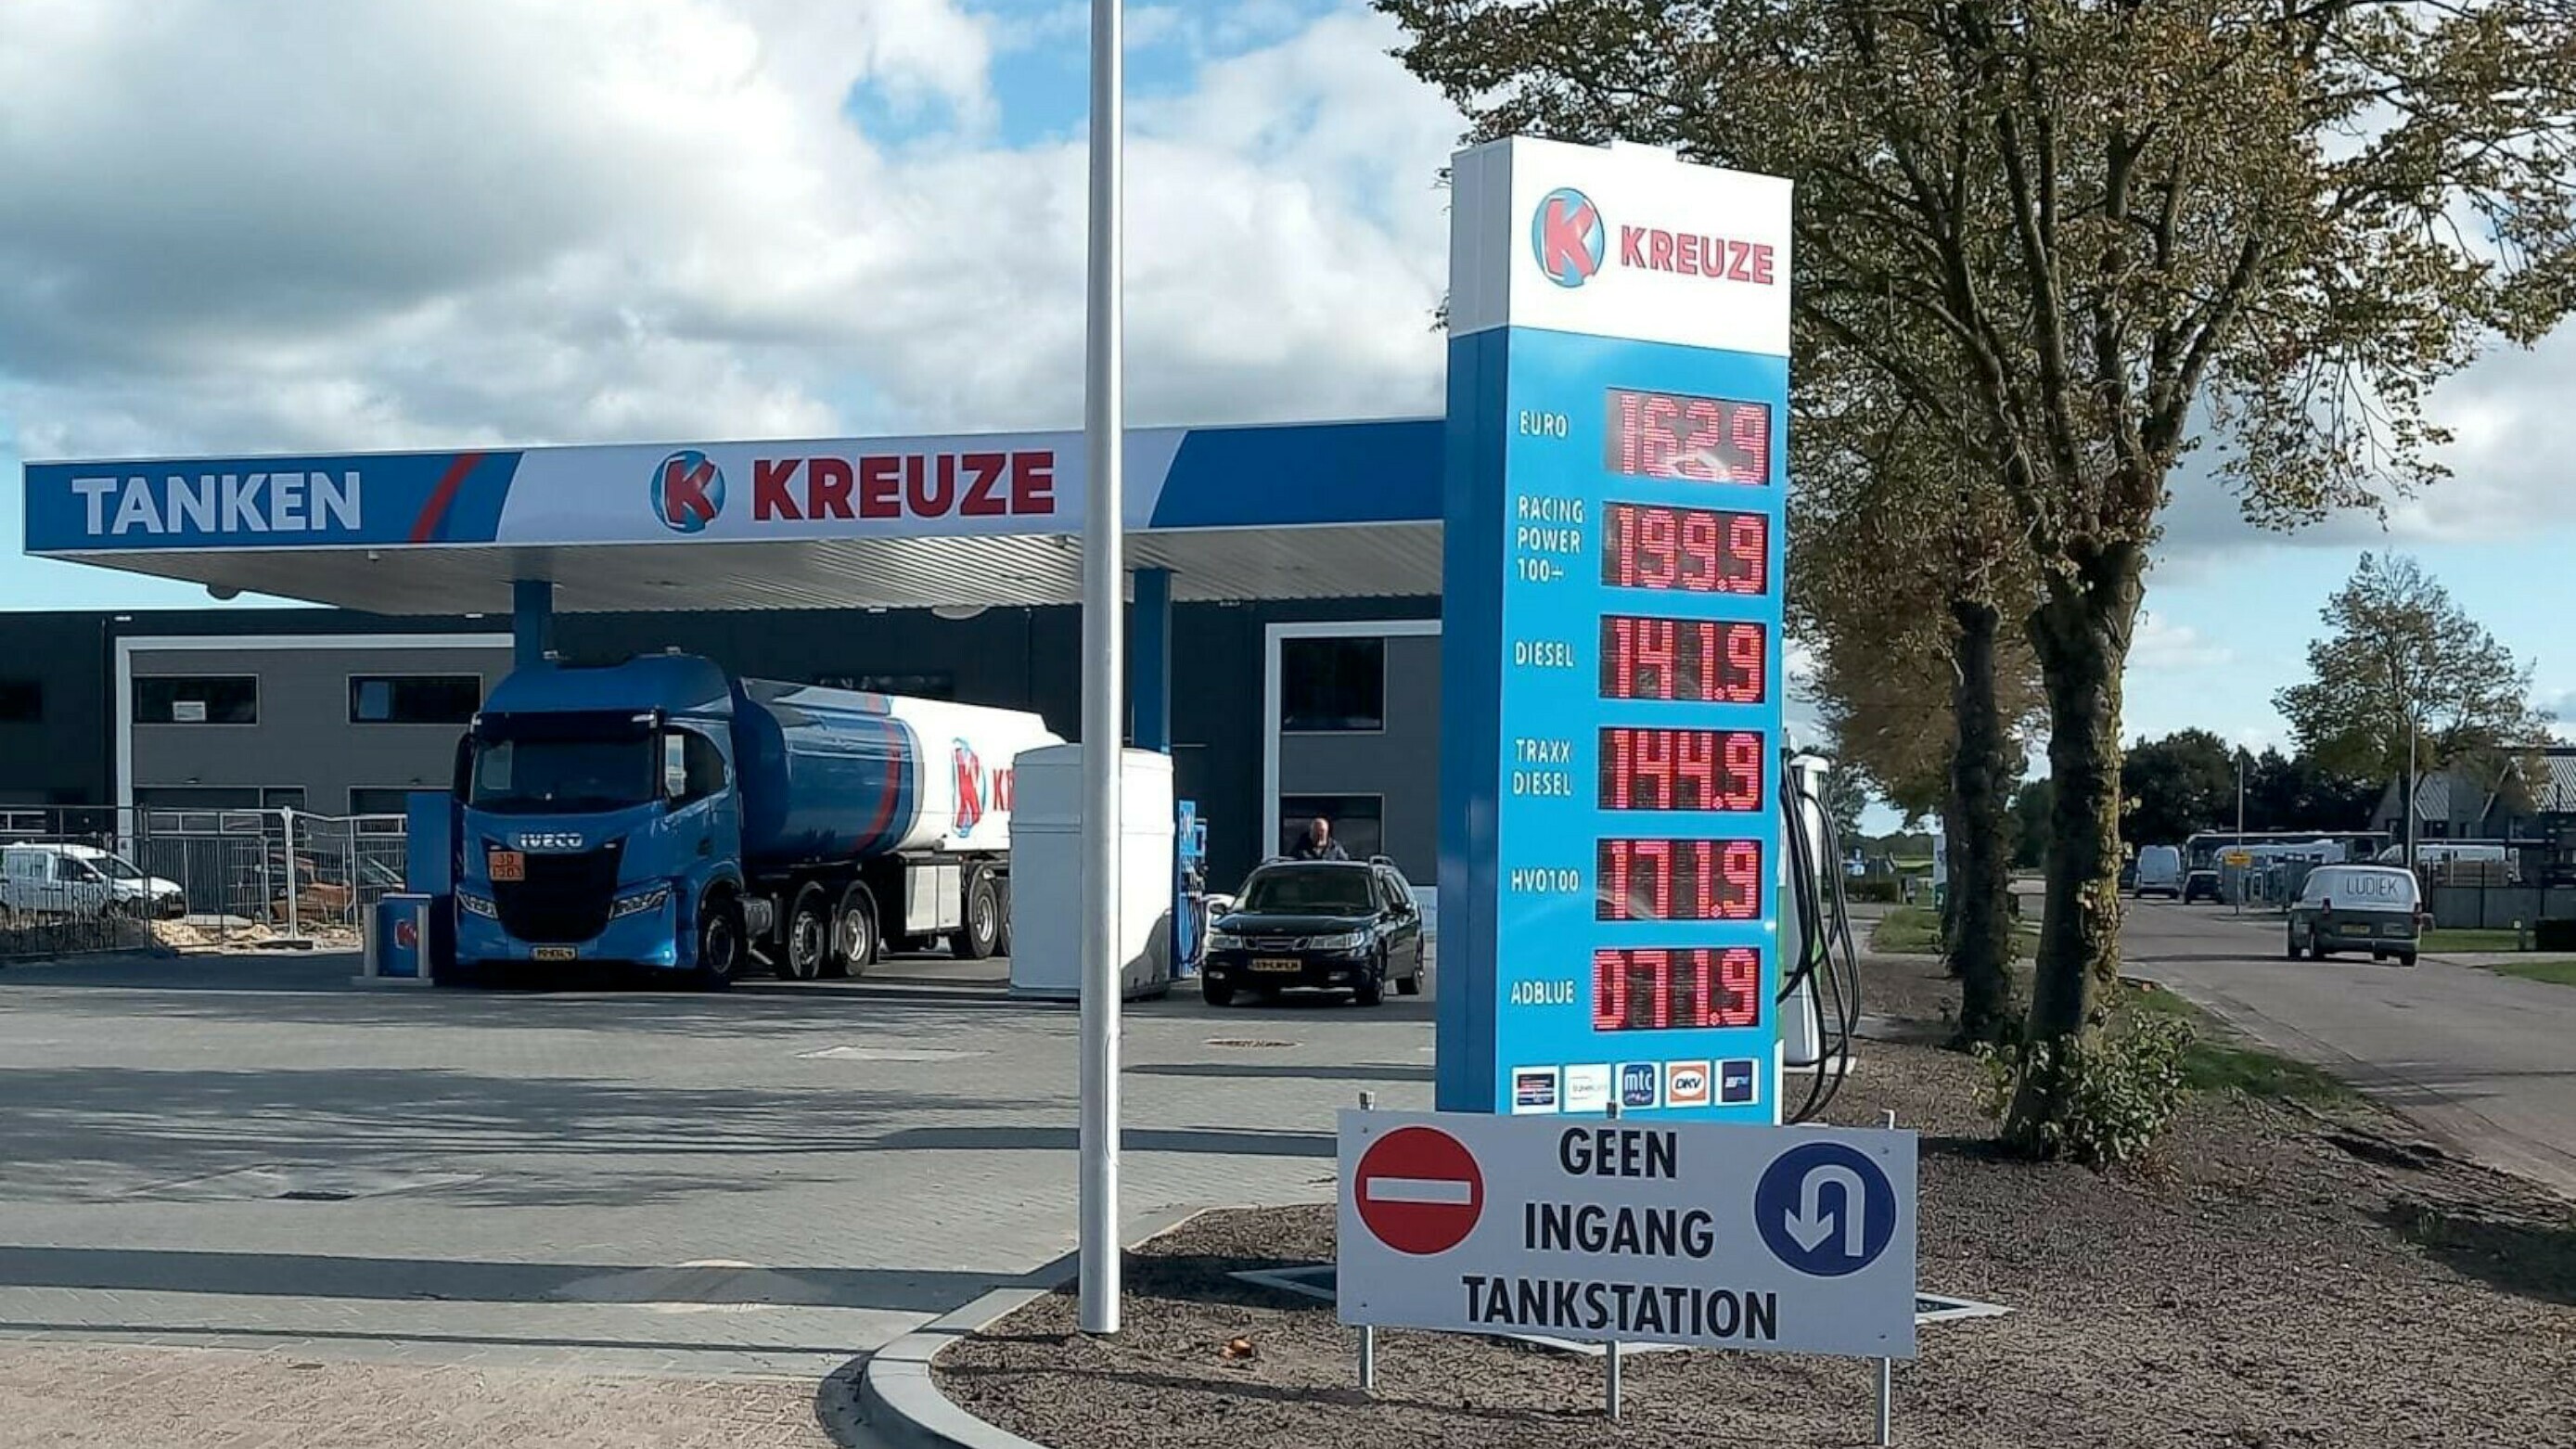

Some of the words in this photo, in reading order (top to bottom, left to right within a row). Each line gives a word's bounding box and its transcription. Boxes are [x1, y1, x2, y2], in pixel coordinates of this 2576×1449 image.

[1621, 224, 1774, 285] KREUZE
[1519, 410, 1568, 437] EURO
[753, 451, 1054, 520] KREUZE
[71, 471, 361, 535] TANKEN
[1518, 495, 1583, 523] RACING
[1517, 527, 1580, 553] POWER
[1619, 507, 1762, 594] 199.9
[1515, 641, 1574, 667] DIESEL
[1616, 619, 1761, 702] 141.9
[1515, 738, 1570, 763] TRAXX
[1513, 771, 1571, 796] DIESEL
[1613, 729, 1759, 811] 144.9
[519, 833, 583, 848] IVECO
[1511, 868, 1579, 892] HVO100
[1611, 840, 1757, 919] 171.9
[2346, 876, 2398, 896] LUDIEK
[1510, 981, 1574, 1006] ADBLUE
[1593, 949, 1756, 1030] 071.9
[1624, 1069, 1653, 1091] mtc
[1675, 1077, 1702, 1090] DKV
[1559, 1127, 1677, 1179] GEEN
[1525, 1202, 1714, 1259] INGANG
[1462, 1275, 1777, 1341] TANKSTATION
